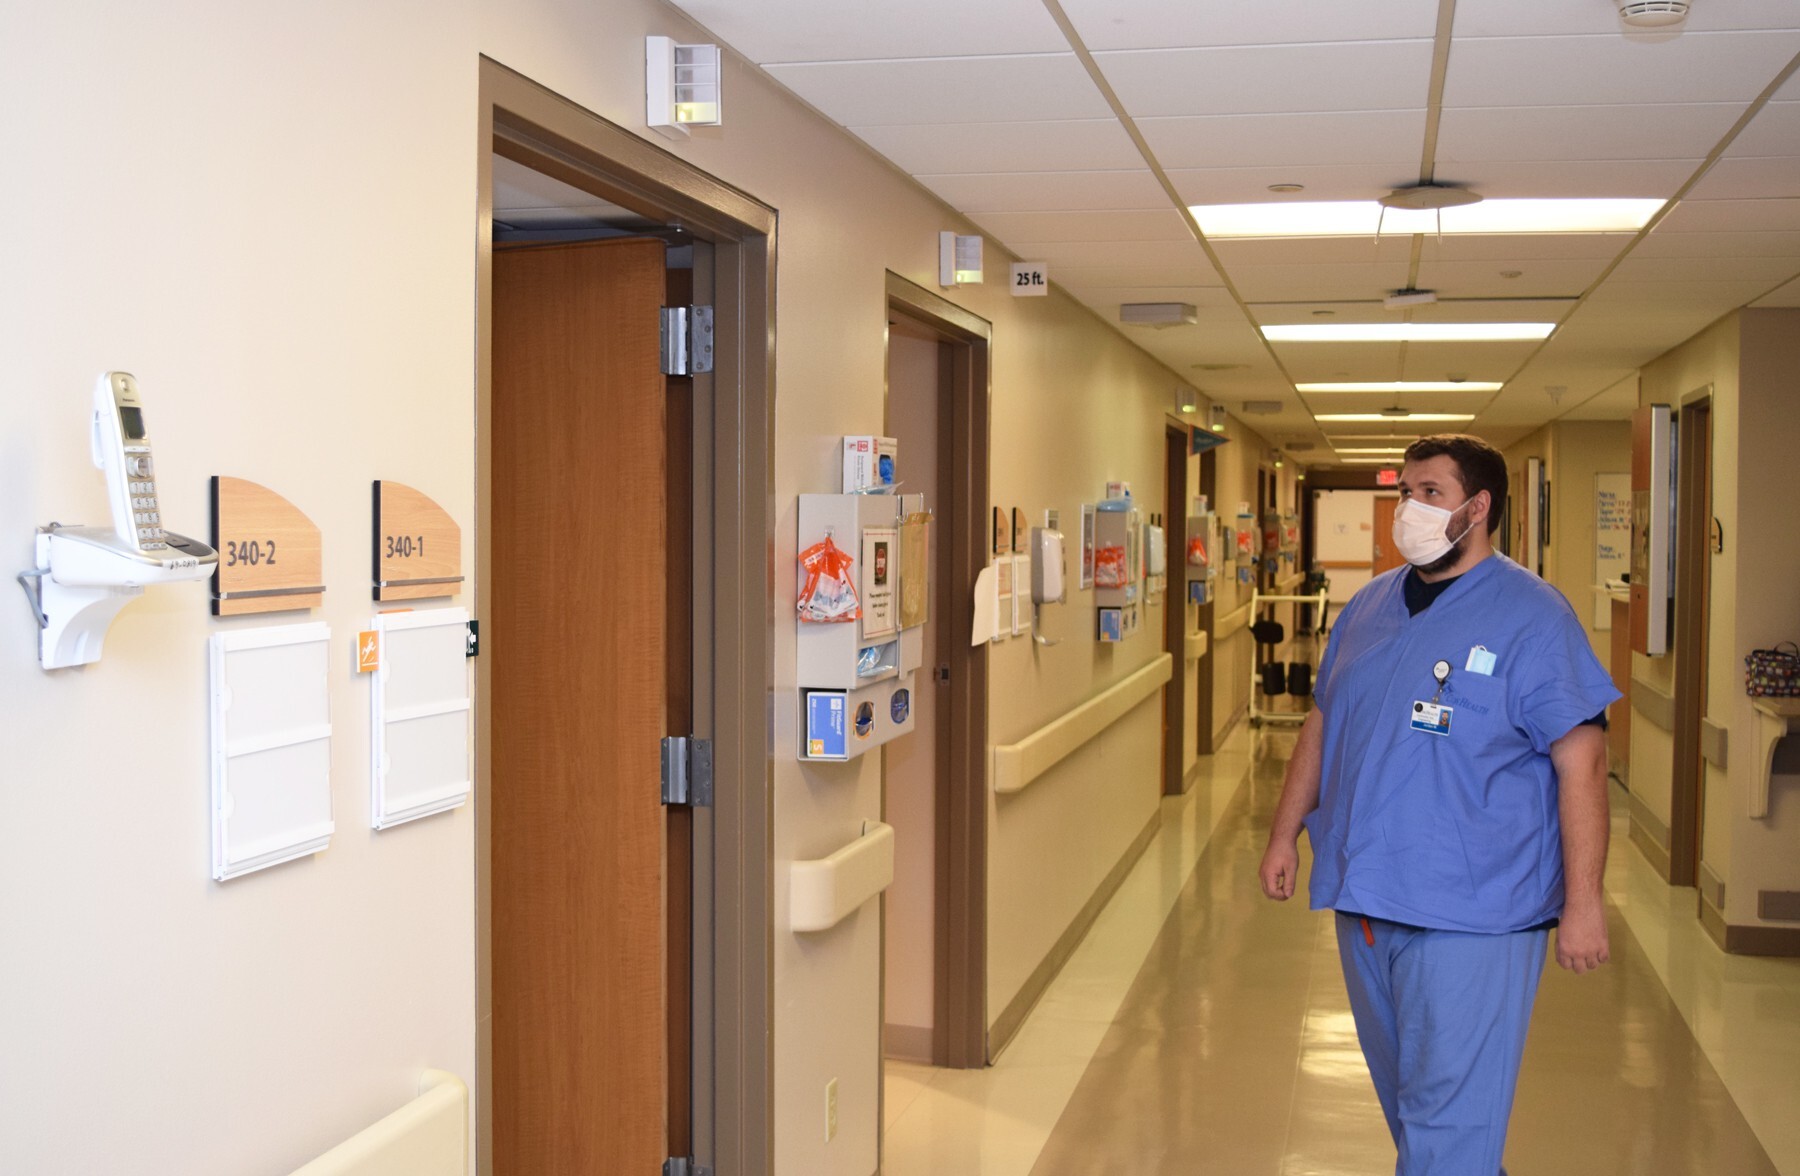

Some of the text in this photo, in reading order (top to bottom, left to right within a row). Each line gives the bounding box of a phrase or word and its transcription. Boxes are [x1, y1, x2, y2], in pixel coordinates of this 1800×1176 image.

[1016, 271, 1044, 286] 25 ft.
[227, 540, 276, 567] 340-2
[386, 535, 423, 558] 340-1
